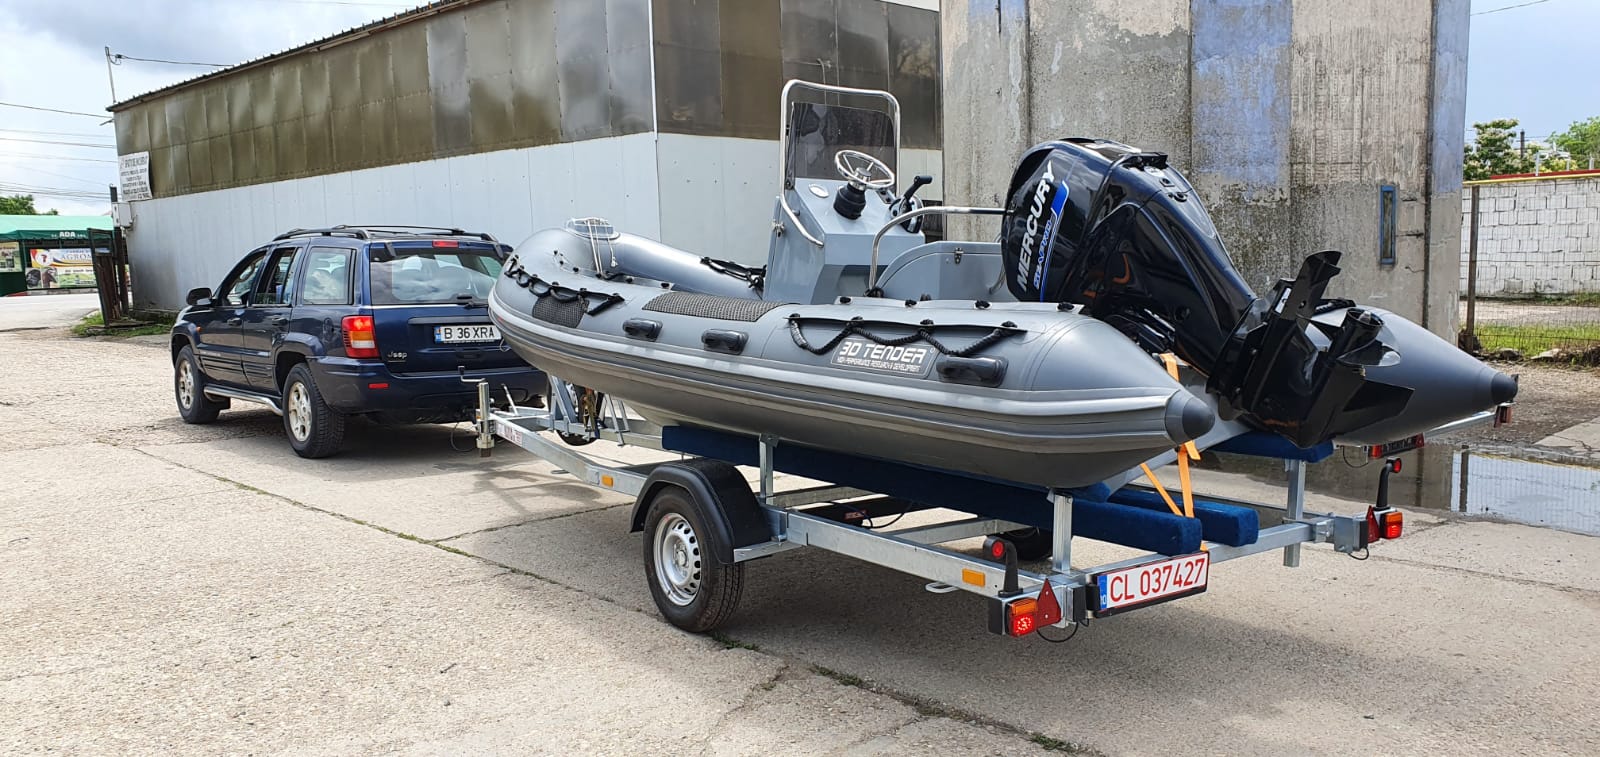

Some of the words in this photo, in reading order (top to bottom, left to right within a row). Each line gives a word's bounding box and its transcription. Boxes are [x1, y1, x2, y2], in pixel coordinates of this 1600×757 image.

[1017, 160, 1054, 292] MERCURY
[444, 327, 453, 339] B
[457, 327, 471, 339] 36
[473, 327, 494, 338] XRA
[388, 351, 407, 359] Jeep
[839, 341, 862, 356] 3D
[863, 344, 928, 364] TENDER
[1110, 573, 1135, 602] CL
[1140, 558, 1205, 596] 037427
